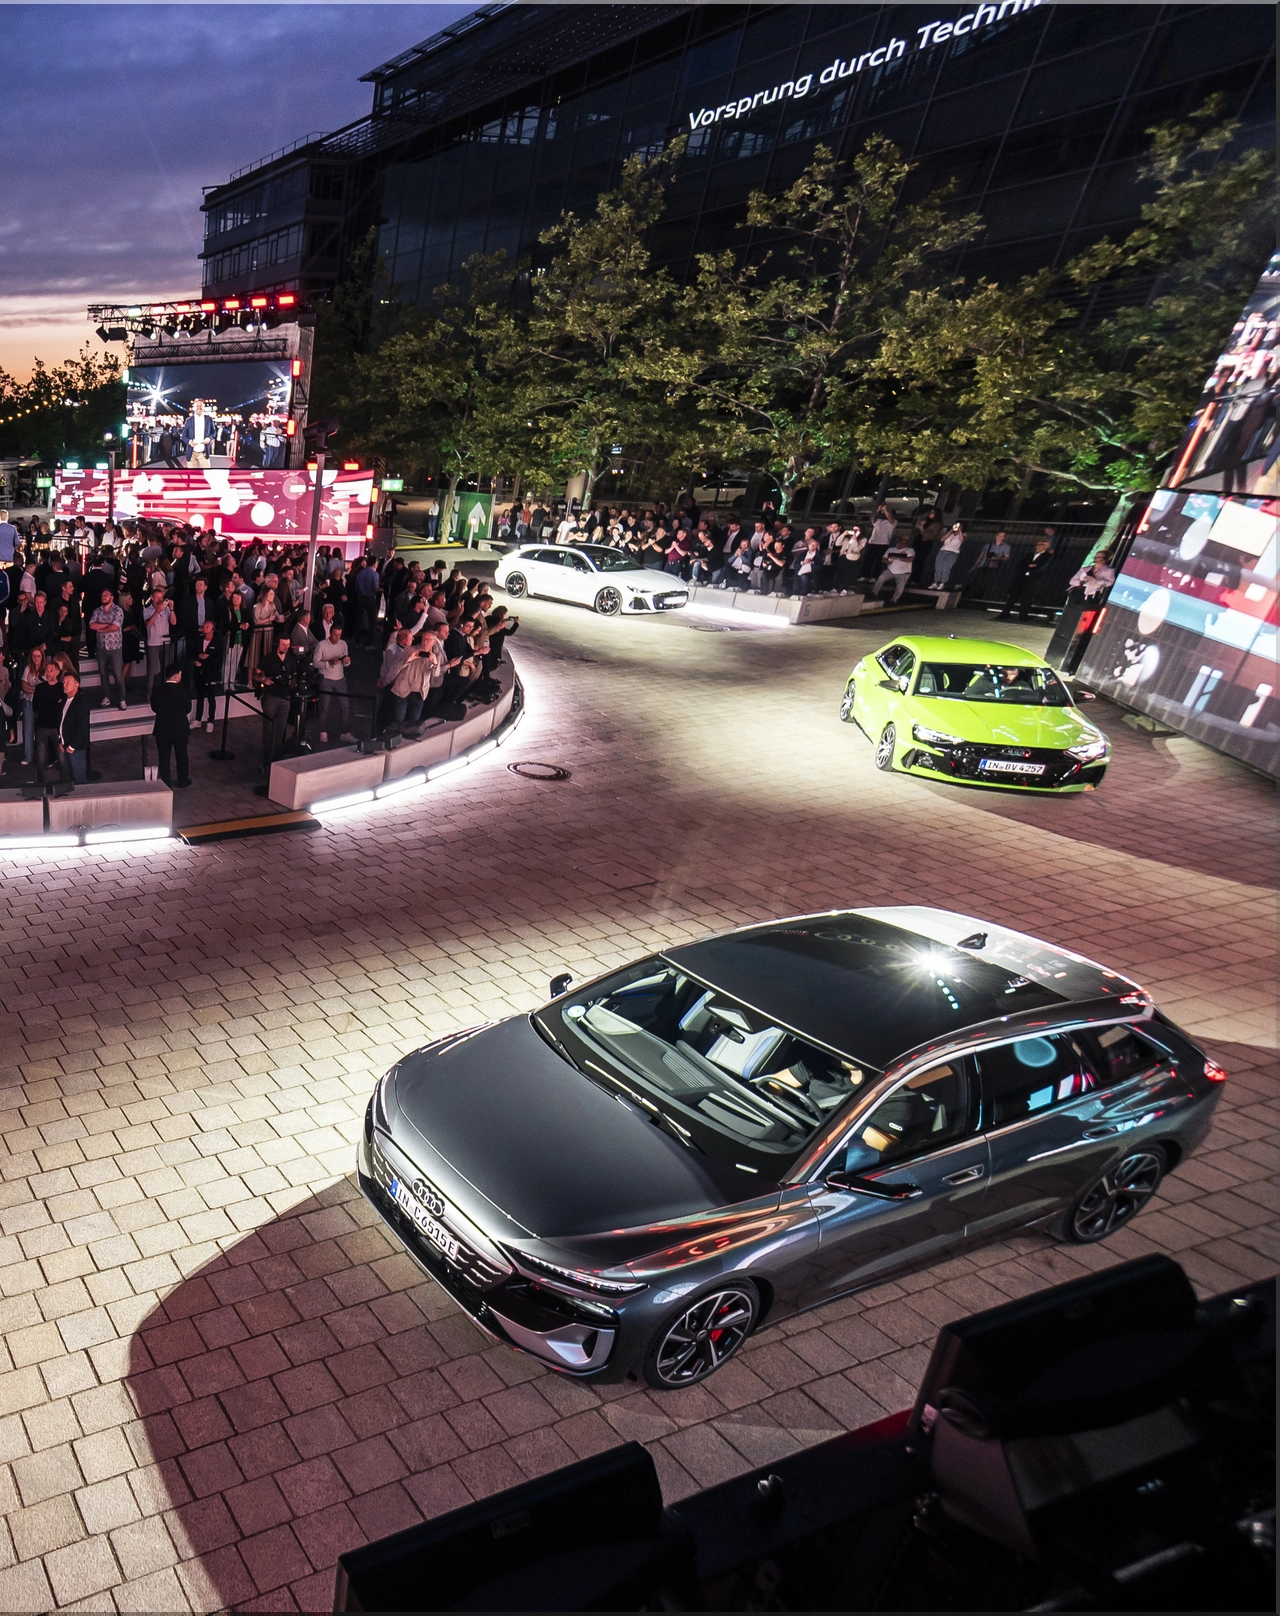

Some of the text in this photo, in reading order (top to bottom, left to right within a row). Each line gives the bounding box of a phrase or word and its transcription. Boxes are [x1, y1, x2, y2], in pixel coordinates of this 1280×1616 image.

[688, 0, 1046, 130] Vorsprung durch Techn
